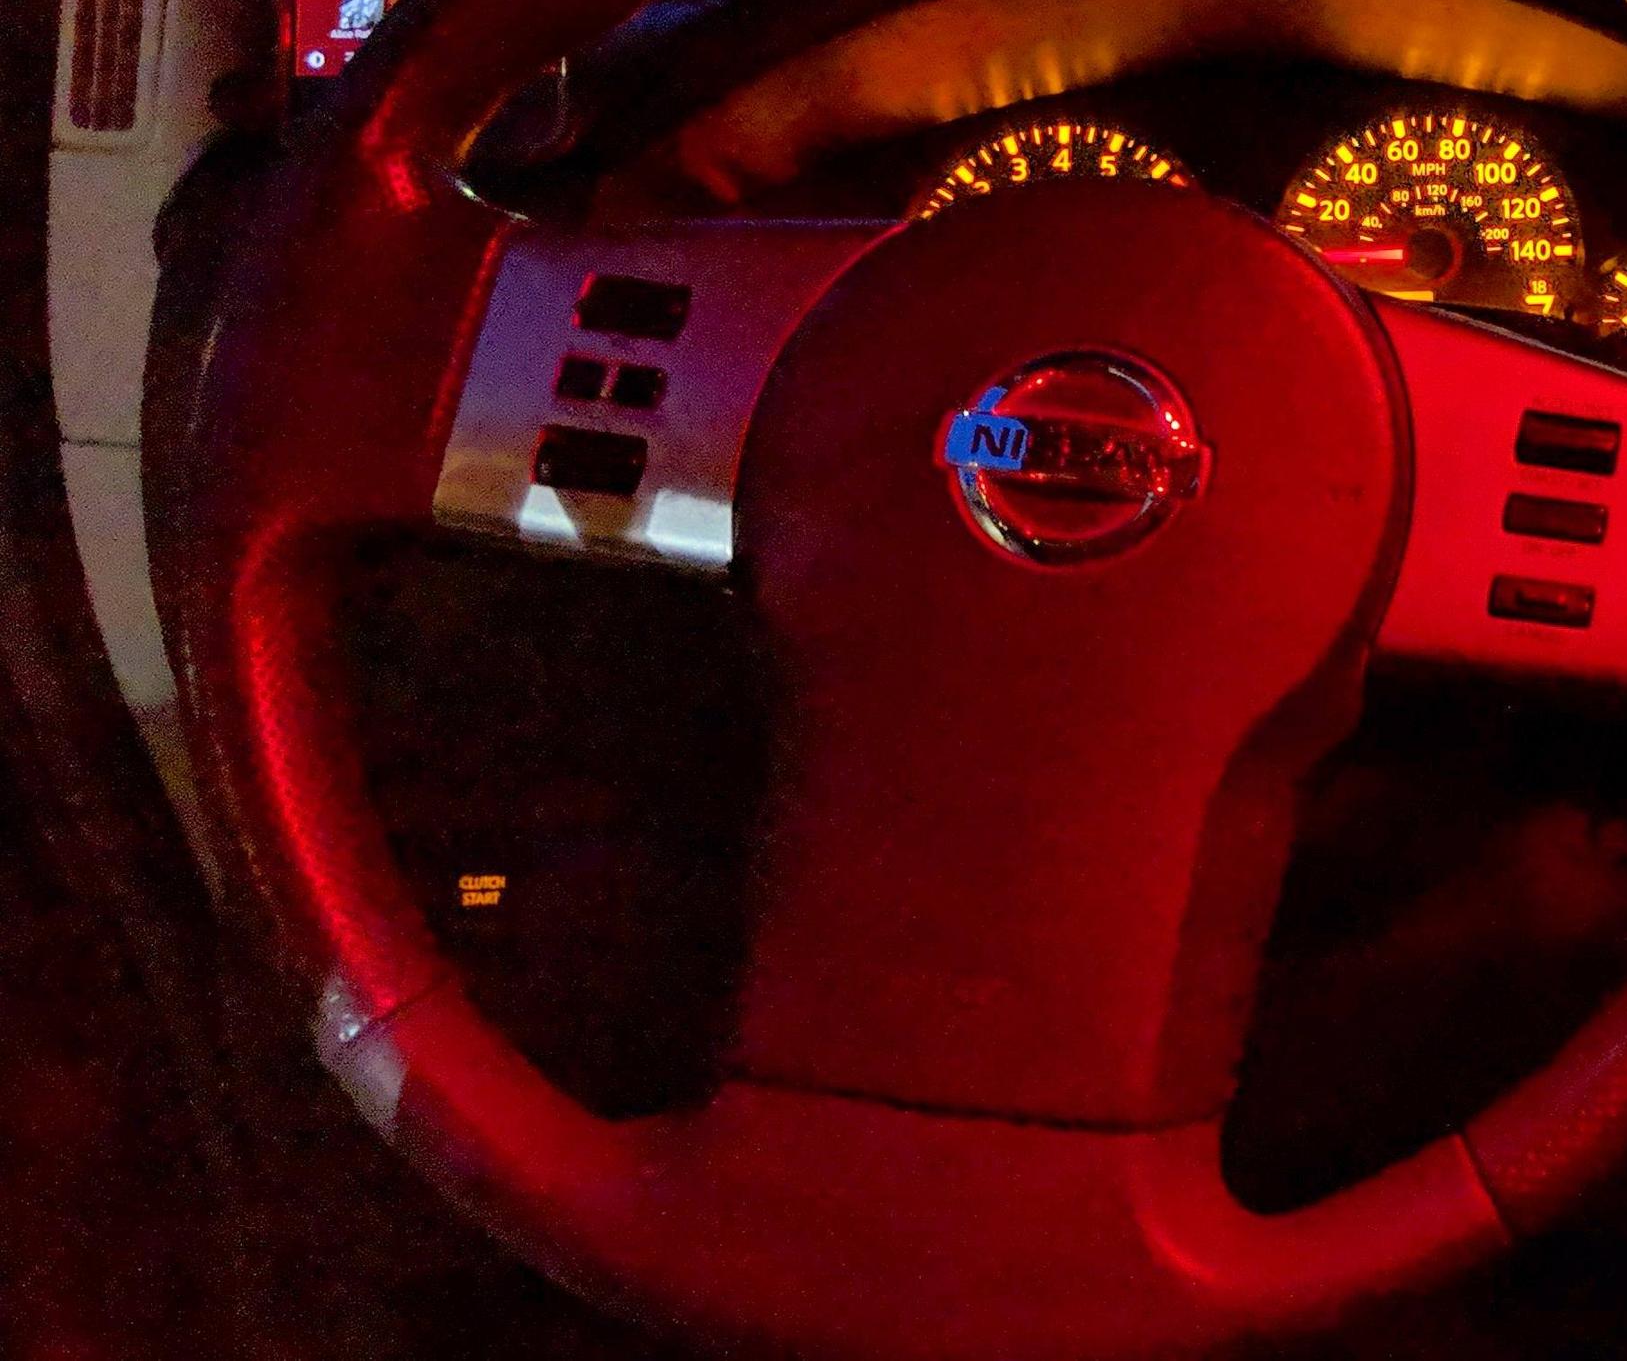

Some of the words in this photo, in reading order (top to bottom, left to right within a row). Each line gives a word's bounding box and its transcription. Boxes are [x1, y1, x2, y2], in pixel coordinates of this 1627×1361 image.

[1387, 139, 1419, 161] 60
[1438, 139, 1471, 160] 80
[1052, 147, 1072, 173] 4
[1100, 155, 1118, 177] 5
[1411, 162, 1446, 176] MPH
[1010, 157, 1028, 182] 3
[1344, 162, 1378, 184] 40
[1475, 162, 1517, 184] 100
[1392, 190, 1409, 202] 80
[1426, 184, 1448, 196] 120
[1319, 199, 1350, 221] 20
[1414, 204, 1446, 217] km/h
[1461, 195, 1483, 208] 160
[1501, 197, 1541, 219] 120
[1361, 216, 1379, 227] 40
[1485, 228, 1510, 240] 200
[1511, 240, 1551, 261] 140
[1531, 280, 1547, 294] 18
[458, 874, 506, 890] CLUTCH
[461, 890, 500, 906] START
